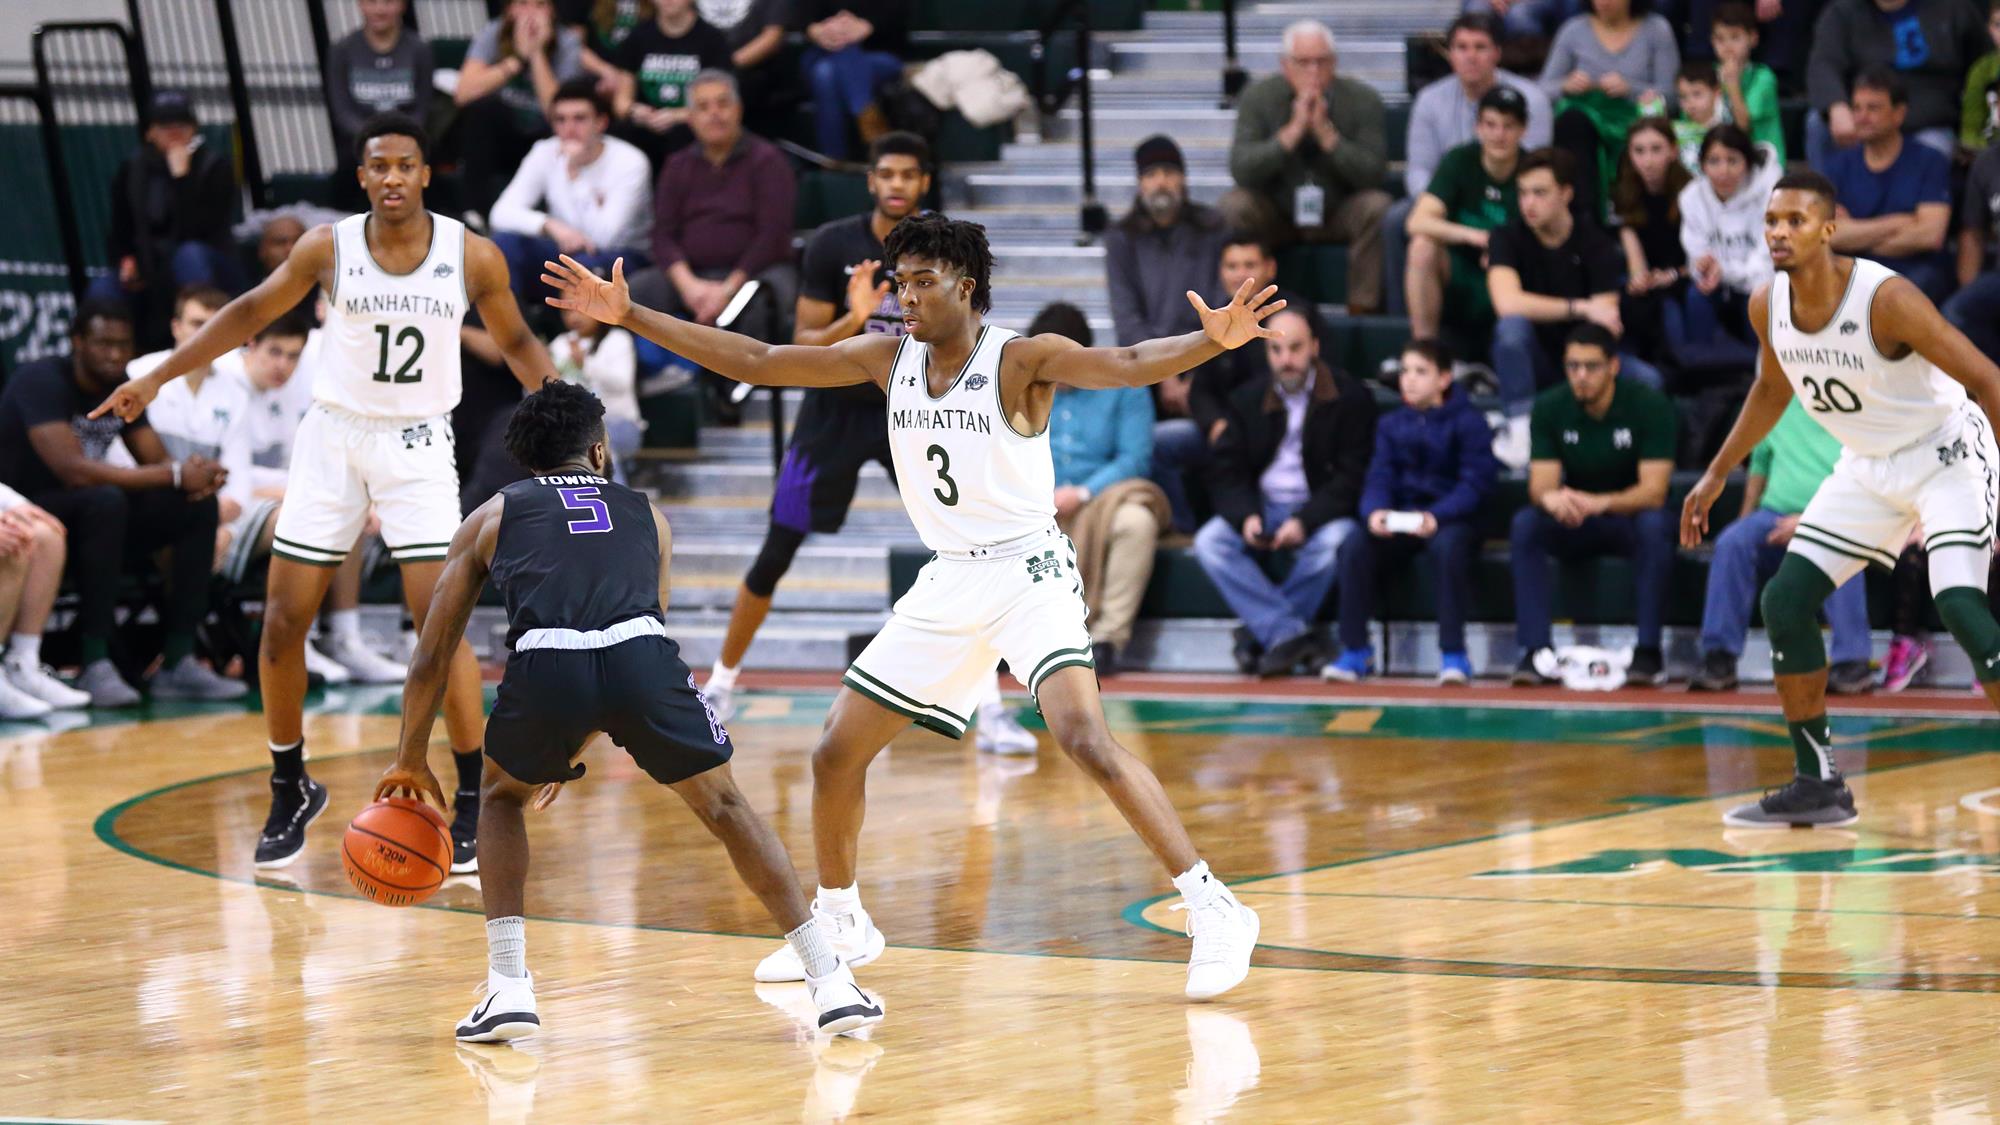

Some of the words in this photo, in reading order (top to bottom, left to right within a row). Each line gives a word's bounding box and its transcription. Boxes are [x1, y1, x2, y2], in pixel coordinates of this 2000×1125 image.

[346, 295, 454, 319] MANHATTAN
[373, 324, 425, 384] 12
[1780, 349, 1865, 372] MANHATTAN
[1802, 376, 1863, 413] 30
[893, 409, 991, 435] MANHATTAN
[534, 475, 609, 485] TOWNS
[926, 444, 959, 507] 3
[556, 486, 614, 535] 5
[1030, 560, 1059, 573] JASPERS
[378, 842, 407, 865] ROCK
